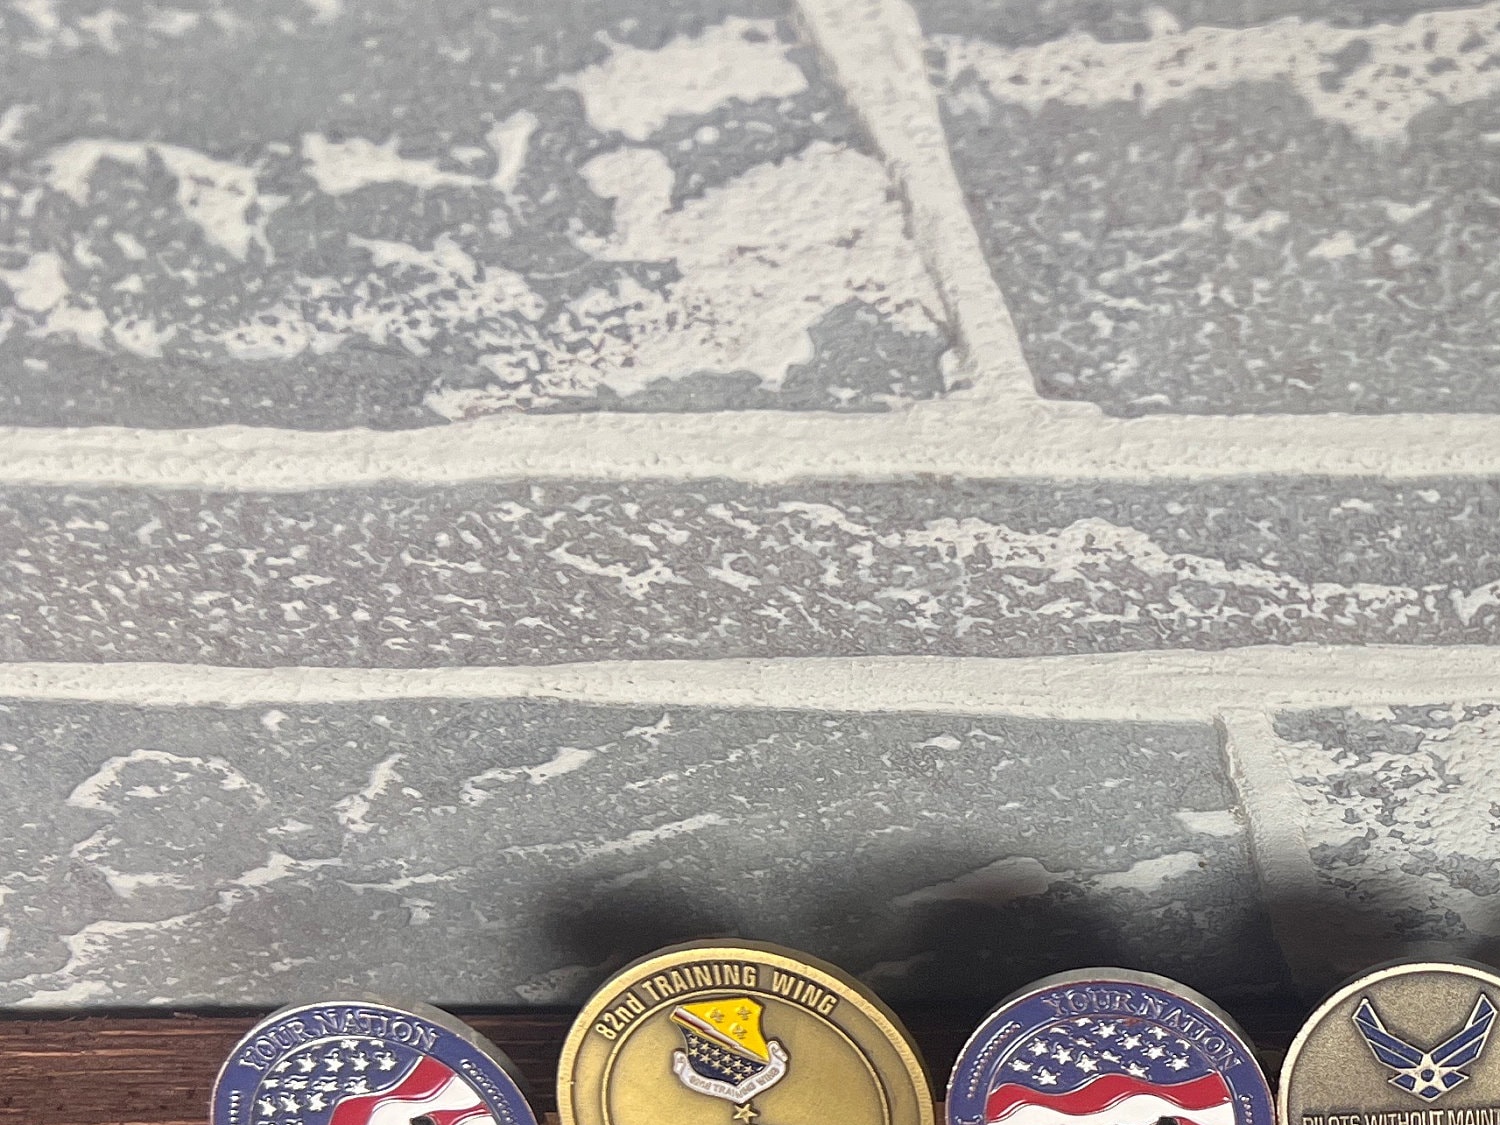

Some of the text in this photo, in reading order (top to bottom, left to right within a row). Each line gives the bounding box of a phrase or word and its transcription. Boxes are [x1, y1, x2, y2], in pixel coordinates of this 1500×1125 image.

[238, 1008, 441, 1072] YOUR NATION
[594, 963, 839, 1041] 82nd TRAINING WING
[1040, 987, 1243, 1071] YOUR NATION
